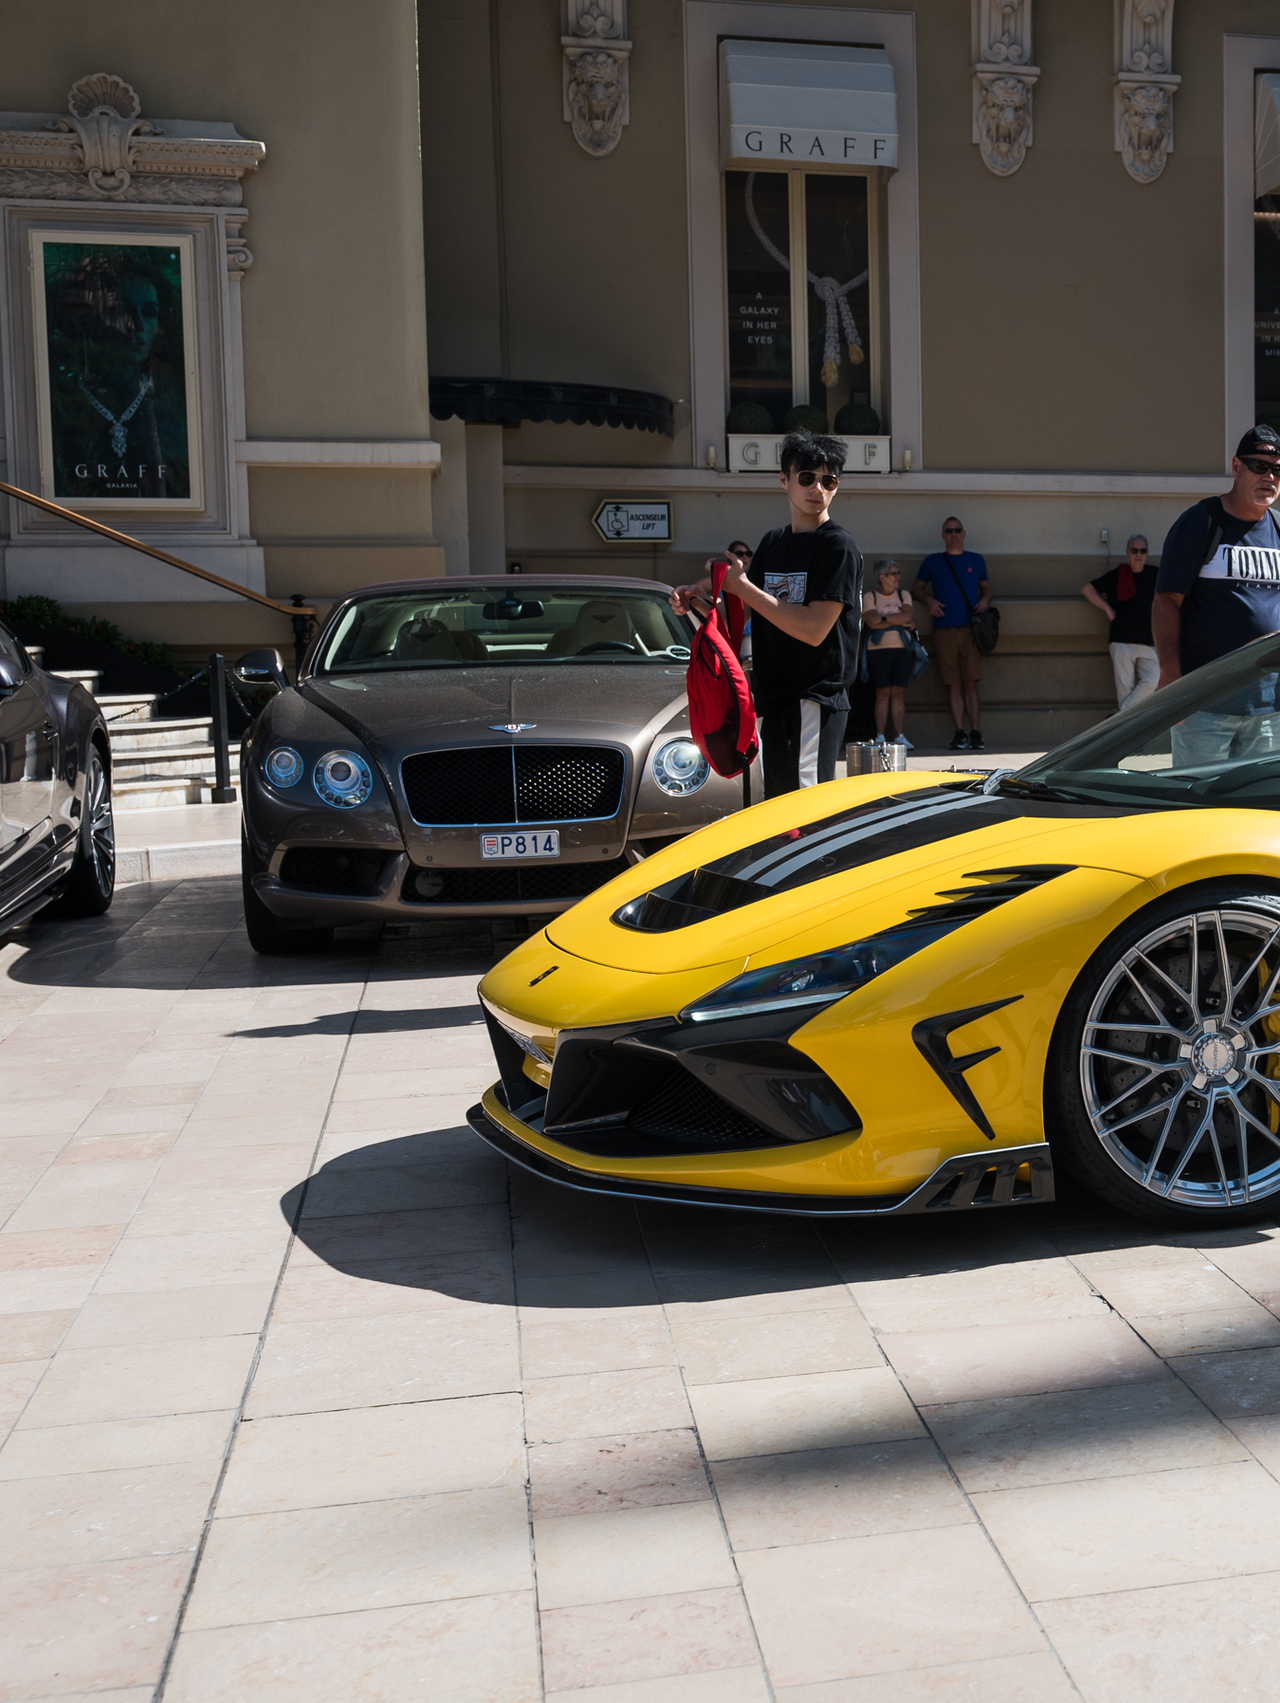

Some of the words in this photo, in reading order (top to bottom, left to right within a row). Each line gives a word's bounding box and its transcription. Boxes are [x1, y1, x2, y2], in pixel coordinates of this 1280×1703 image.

[745, 131, 886, 159] GRAFF
[740, 306, 779, 315] GALAXY
[743, 321, 753, 329] IN
[748, 336, 773, 344] EYES
[75, 463, 167, 478] GRAFF
[1236, 582, 1280, 591] JEANS
[501, 834, 554, 855] P814
